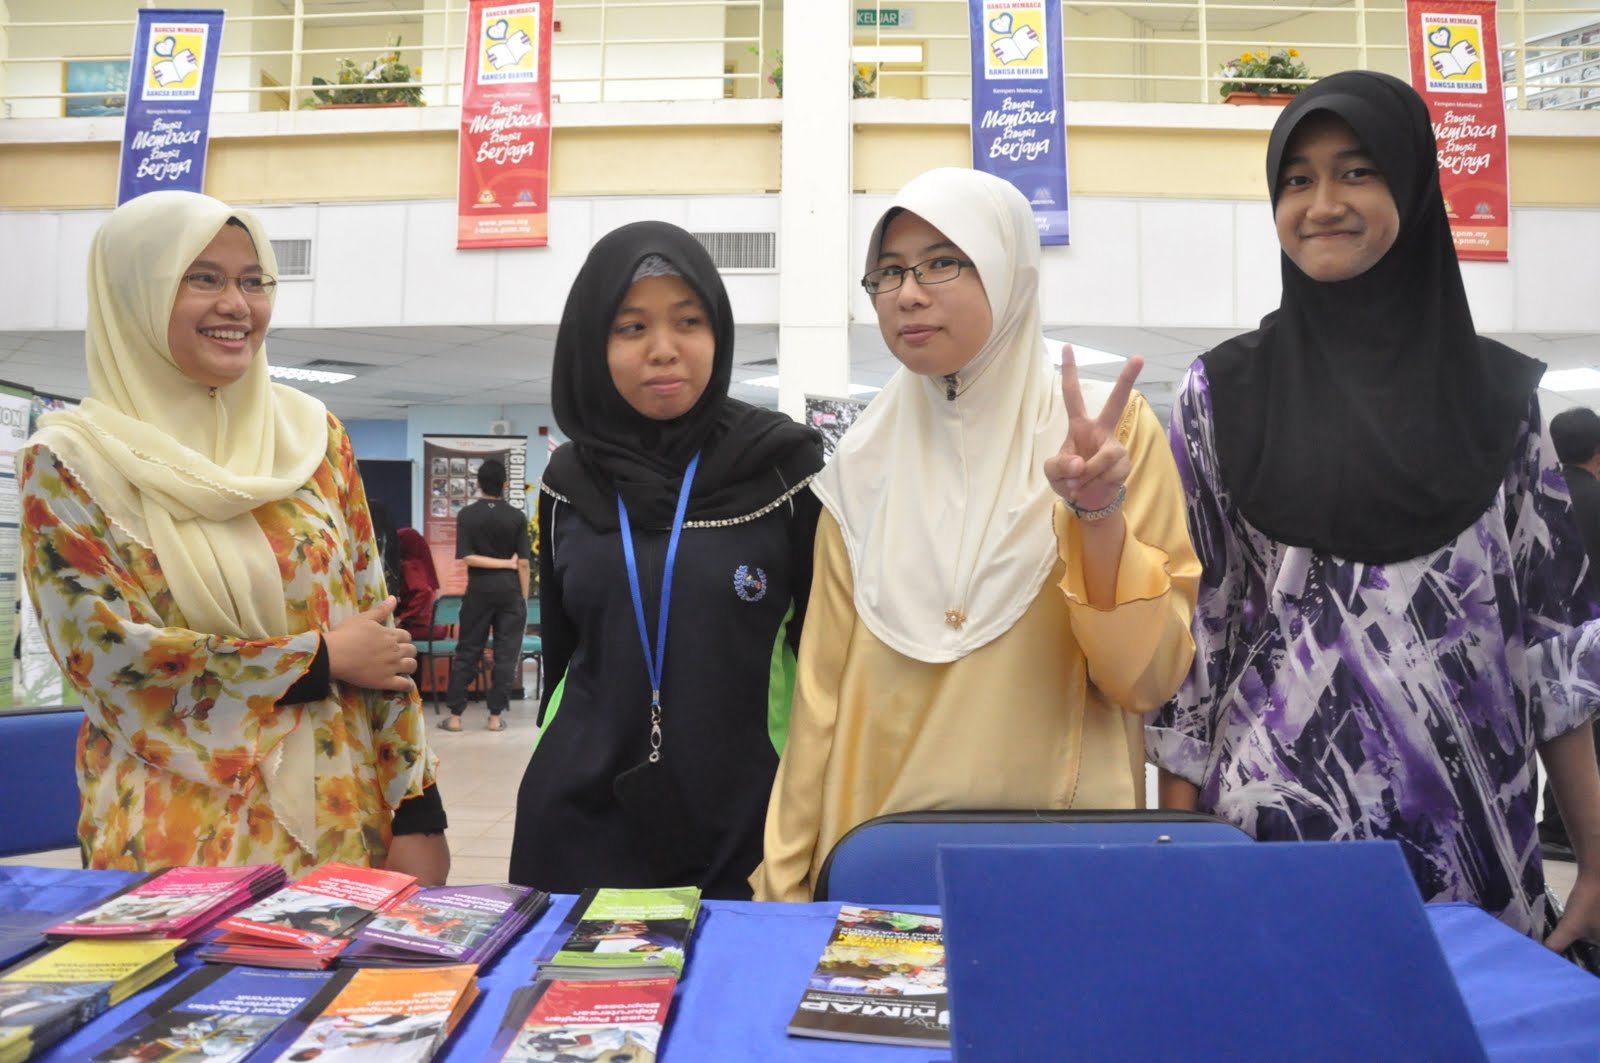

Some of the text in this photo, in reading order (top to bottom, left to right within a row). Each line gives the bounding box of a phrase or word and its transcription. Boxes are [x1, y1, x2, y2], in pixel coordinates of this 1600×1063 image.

[469, 112, 543, 134] Membaca
[981, 109, 1057, 129] Membaca
[131, 129, 201, 150] Membaca
[989, 137, 1050, 161] Berjaya
[476, 141, 535, 165] Berjaya
[136, 158, 192, 181] Berjaya
[251, 1007, 292, 1015] Pusat
[408, 1004, 449, 1012] Pusat
[572, 1008, 657, 1016] Kejuruteraan
[593, 1002, 660, 1010] Bioproses
[615, 1014, 656, 1022] Pusat
